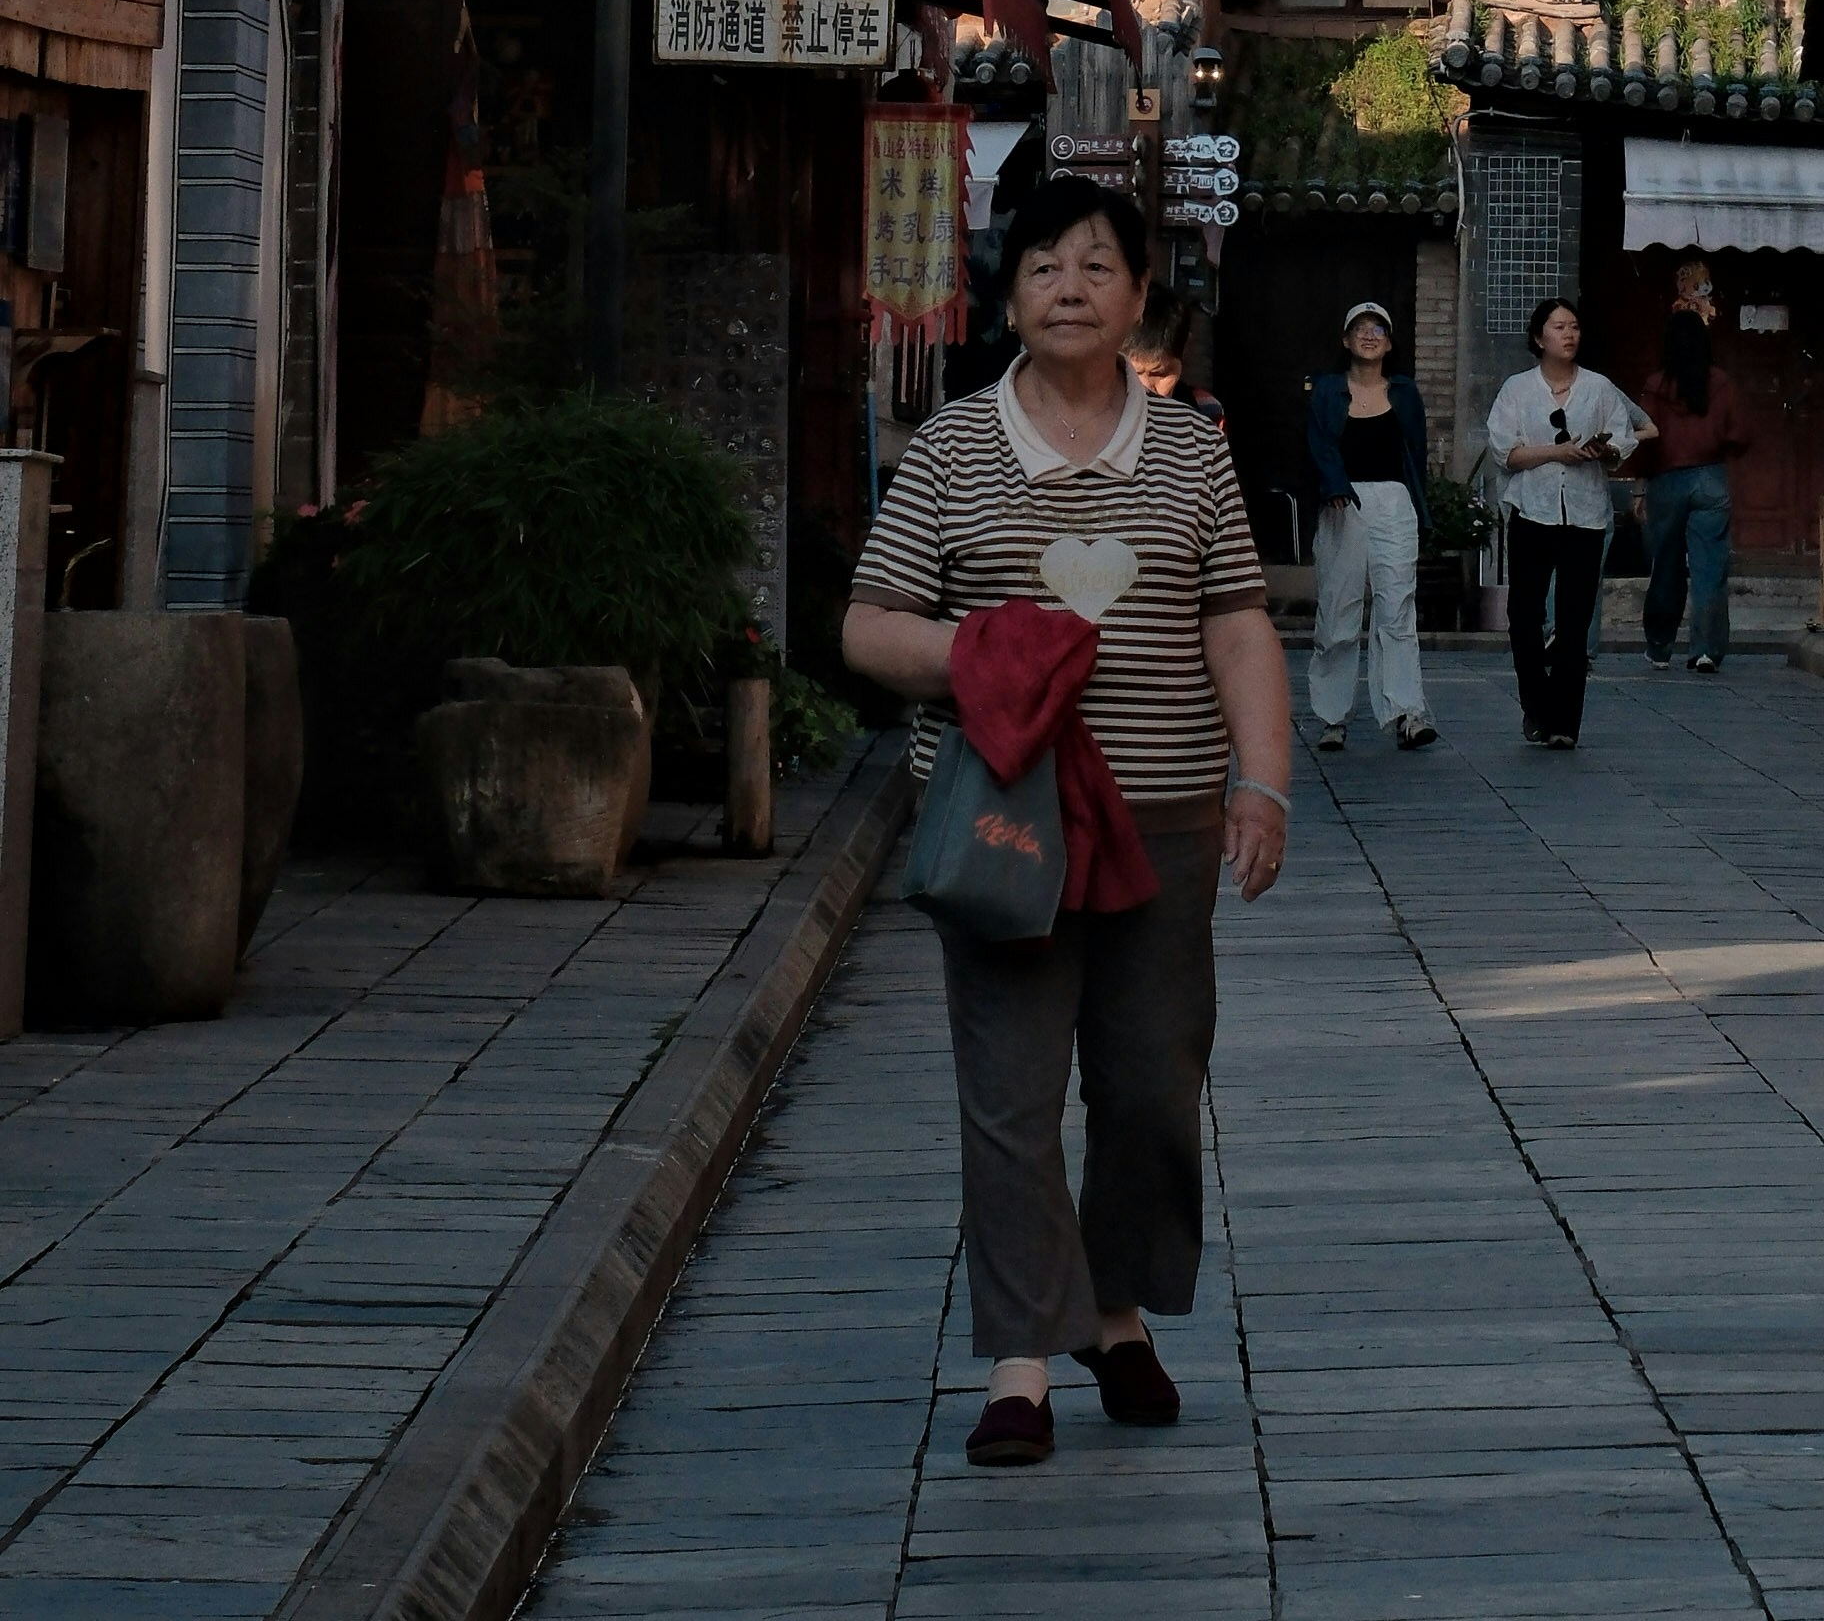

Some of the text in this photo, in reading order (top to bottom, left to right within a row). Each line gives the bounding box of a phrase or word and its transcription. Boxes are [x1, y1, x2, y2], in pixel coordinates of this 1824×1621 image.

[782, 0, 880, 56] 禁止停车
[874, 211, 956, 245] 烤乳扇
